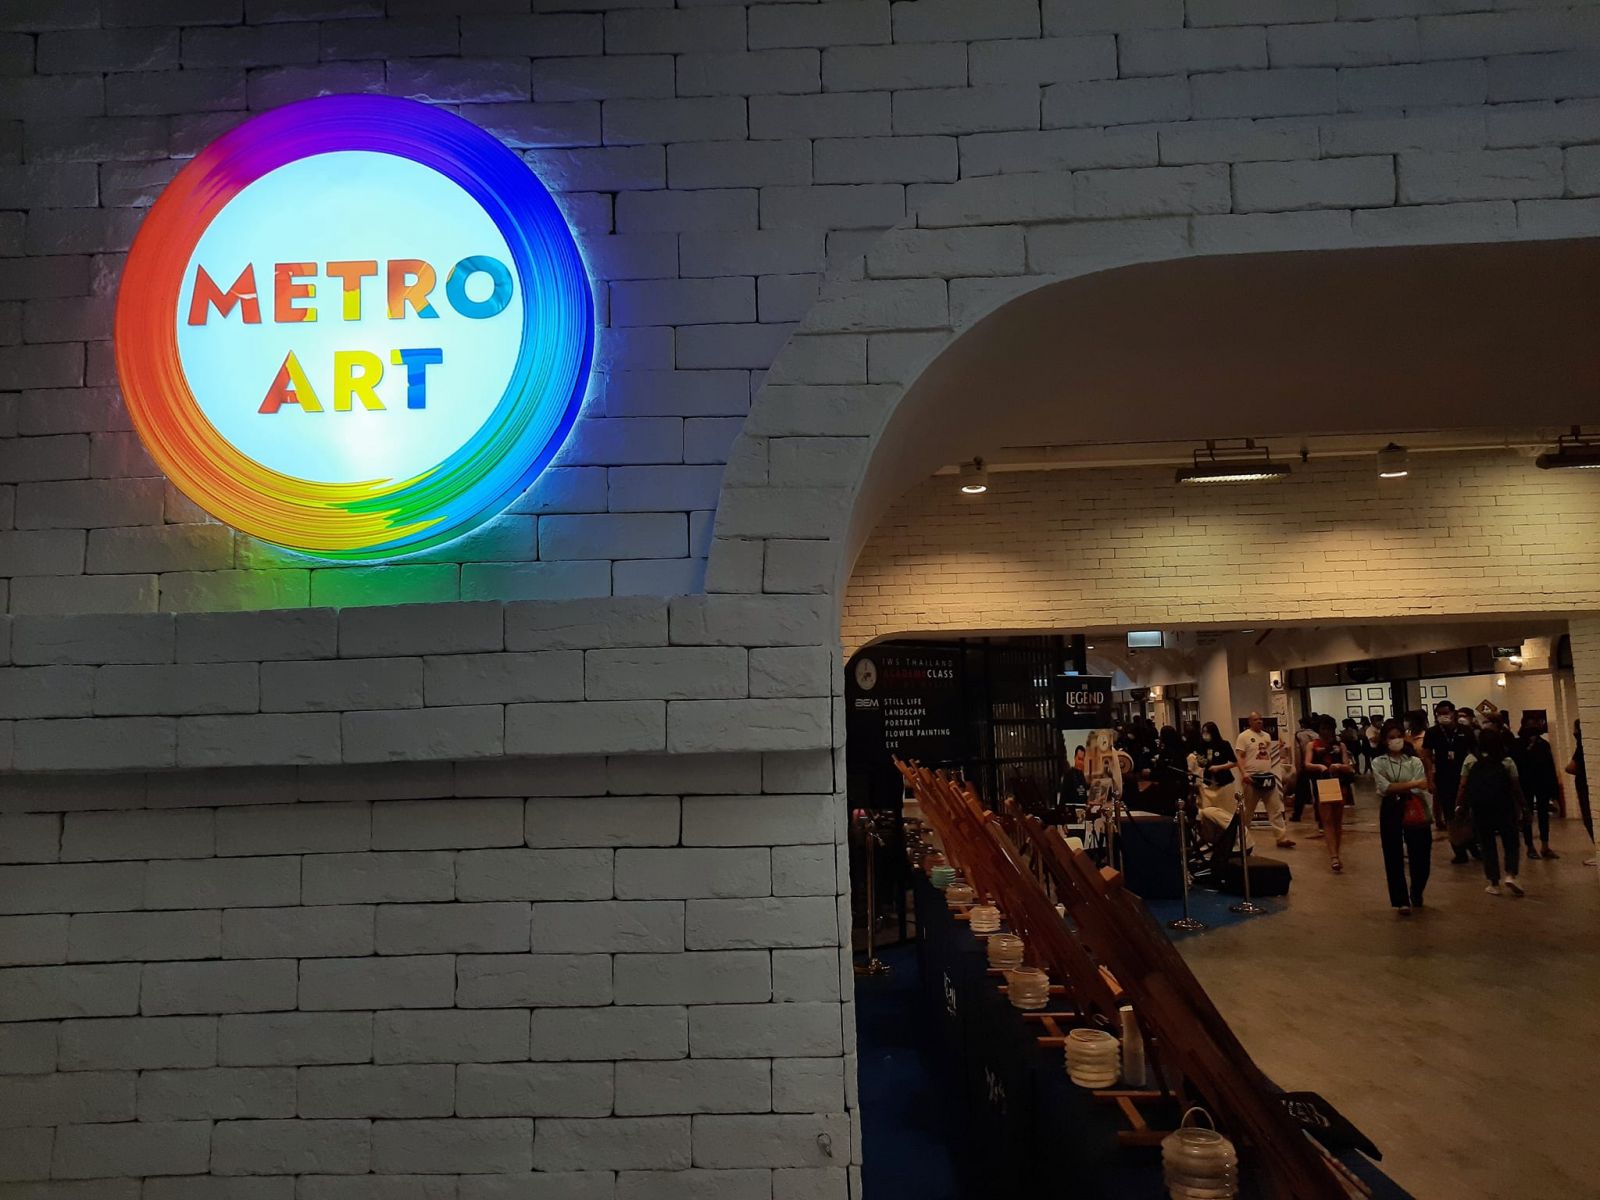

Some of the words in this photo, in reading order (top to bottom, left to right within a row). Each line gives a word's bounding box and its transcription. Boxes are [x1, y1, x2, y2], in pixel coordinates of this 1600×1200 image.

[188, 254, 514, 326] METRO
[258, 347, 443, 414] ART
[906, 658, 953, 667] THAILAND
[926, 669, 953, 679] CLASS
[884, 698, 904, 706] STILL
[907, 698, 922, 706] LIFE
[1065, 691, 1104, 708] LEGEND
[884, 708, 926, 717] LANDSCAPE
[885, 719, 921, 727] PORTRAIT
[885, 730, 914, 738] FLOWER
[916, 728, 951, 737] PAINTING
